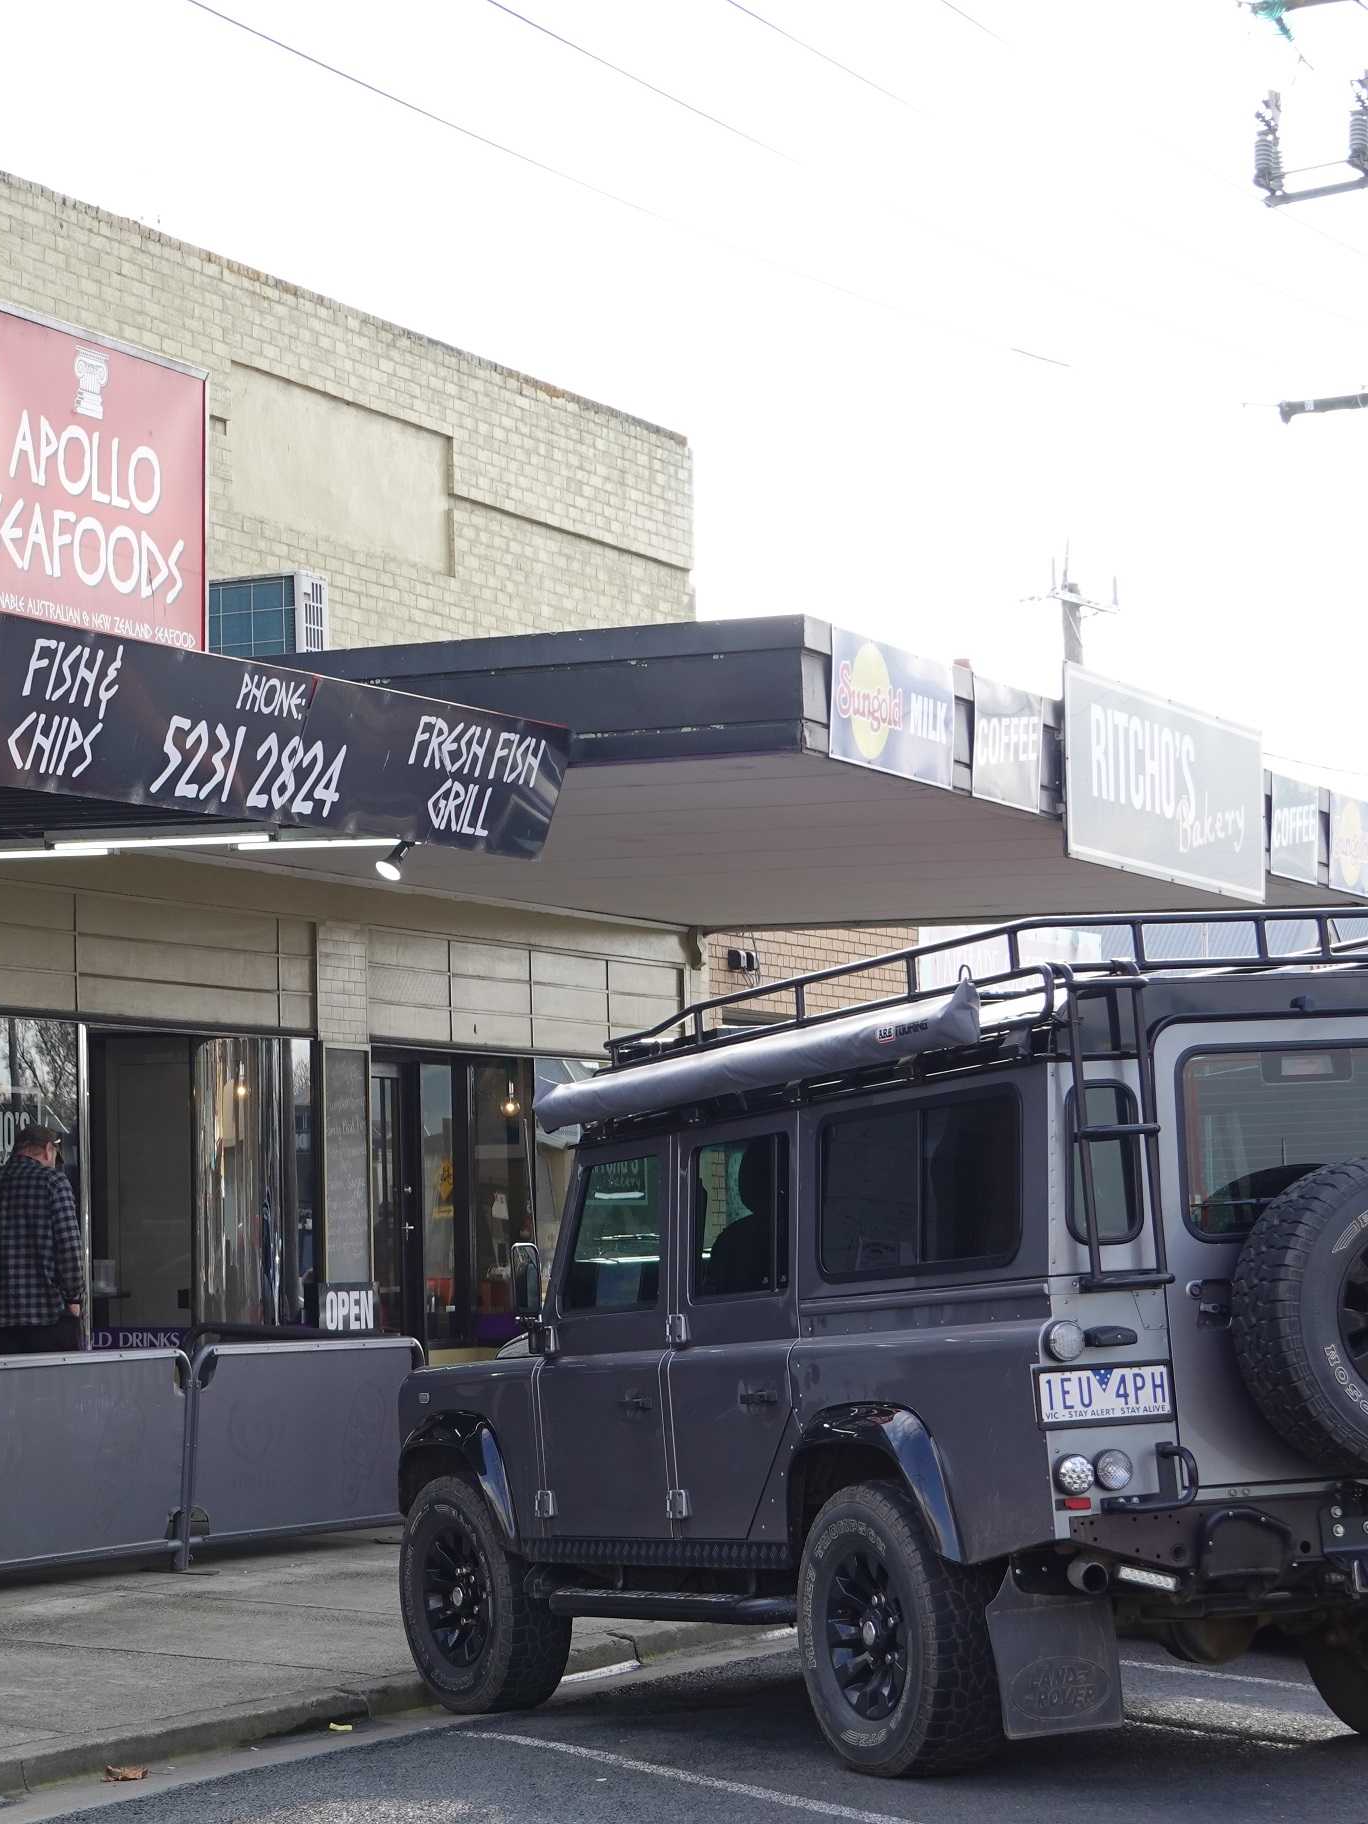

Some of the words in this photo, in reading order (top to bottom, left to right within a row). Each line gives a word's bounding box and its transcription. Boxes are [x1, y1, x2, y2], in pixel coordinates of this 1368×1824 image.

[9, 409, 161, 514] APOLLO
[27, 598, 81, 624] AUSTRALIAN
[92, 613, 111, 630] NEW
[113, 617, 152, 640] ZEALAND
[154, 626, 196, 648] SEAFOOD
[236, 673, 307, 720] PHONE:
[837, 661, 904, 732] Sungold
[910, 693, 948, 745] MILK
[7, 711, 104, 778] CHIPS
[150, 715, 248, 802] 5231
[246, 732, 348, 818] 2824
[408, 716, 492, 777] FRESH
[488, 732, 547, 788] FISH
[977, 716, 1040, 766] COFFEE
[1091, 703, 1196, 825] RITCHO'S
[428, 778, 493, 837] GRILL
[1177, 791, 1246, 853] Bakery
[1274, 803, 1316, 848] COFFEE
[326, 1290, 374, 1331] OPEN
[119, 1331, 181, 1348] DRINKS
[1045, 1376, 1093, 1410] 1EU
[1115, 1371, 1167, 1406] 4PH
[1045, 1411, 1059, 1420] VIC
[1067, 1408, 1089, 1419] STAY
[1090, 1407, 1115, 1417] ALERT
[1120, 1405, 1141, 1415] STAY
[1142, 1404, 1167, 1414] ALIVE
